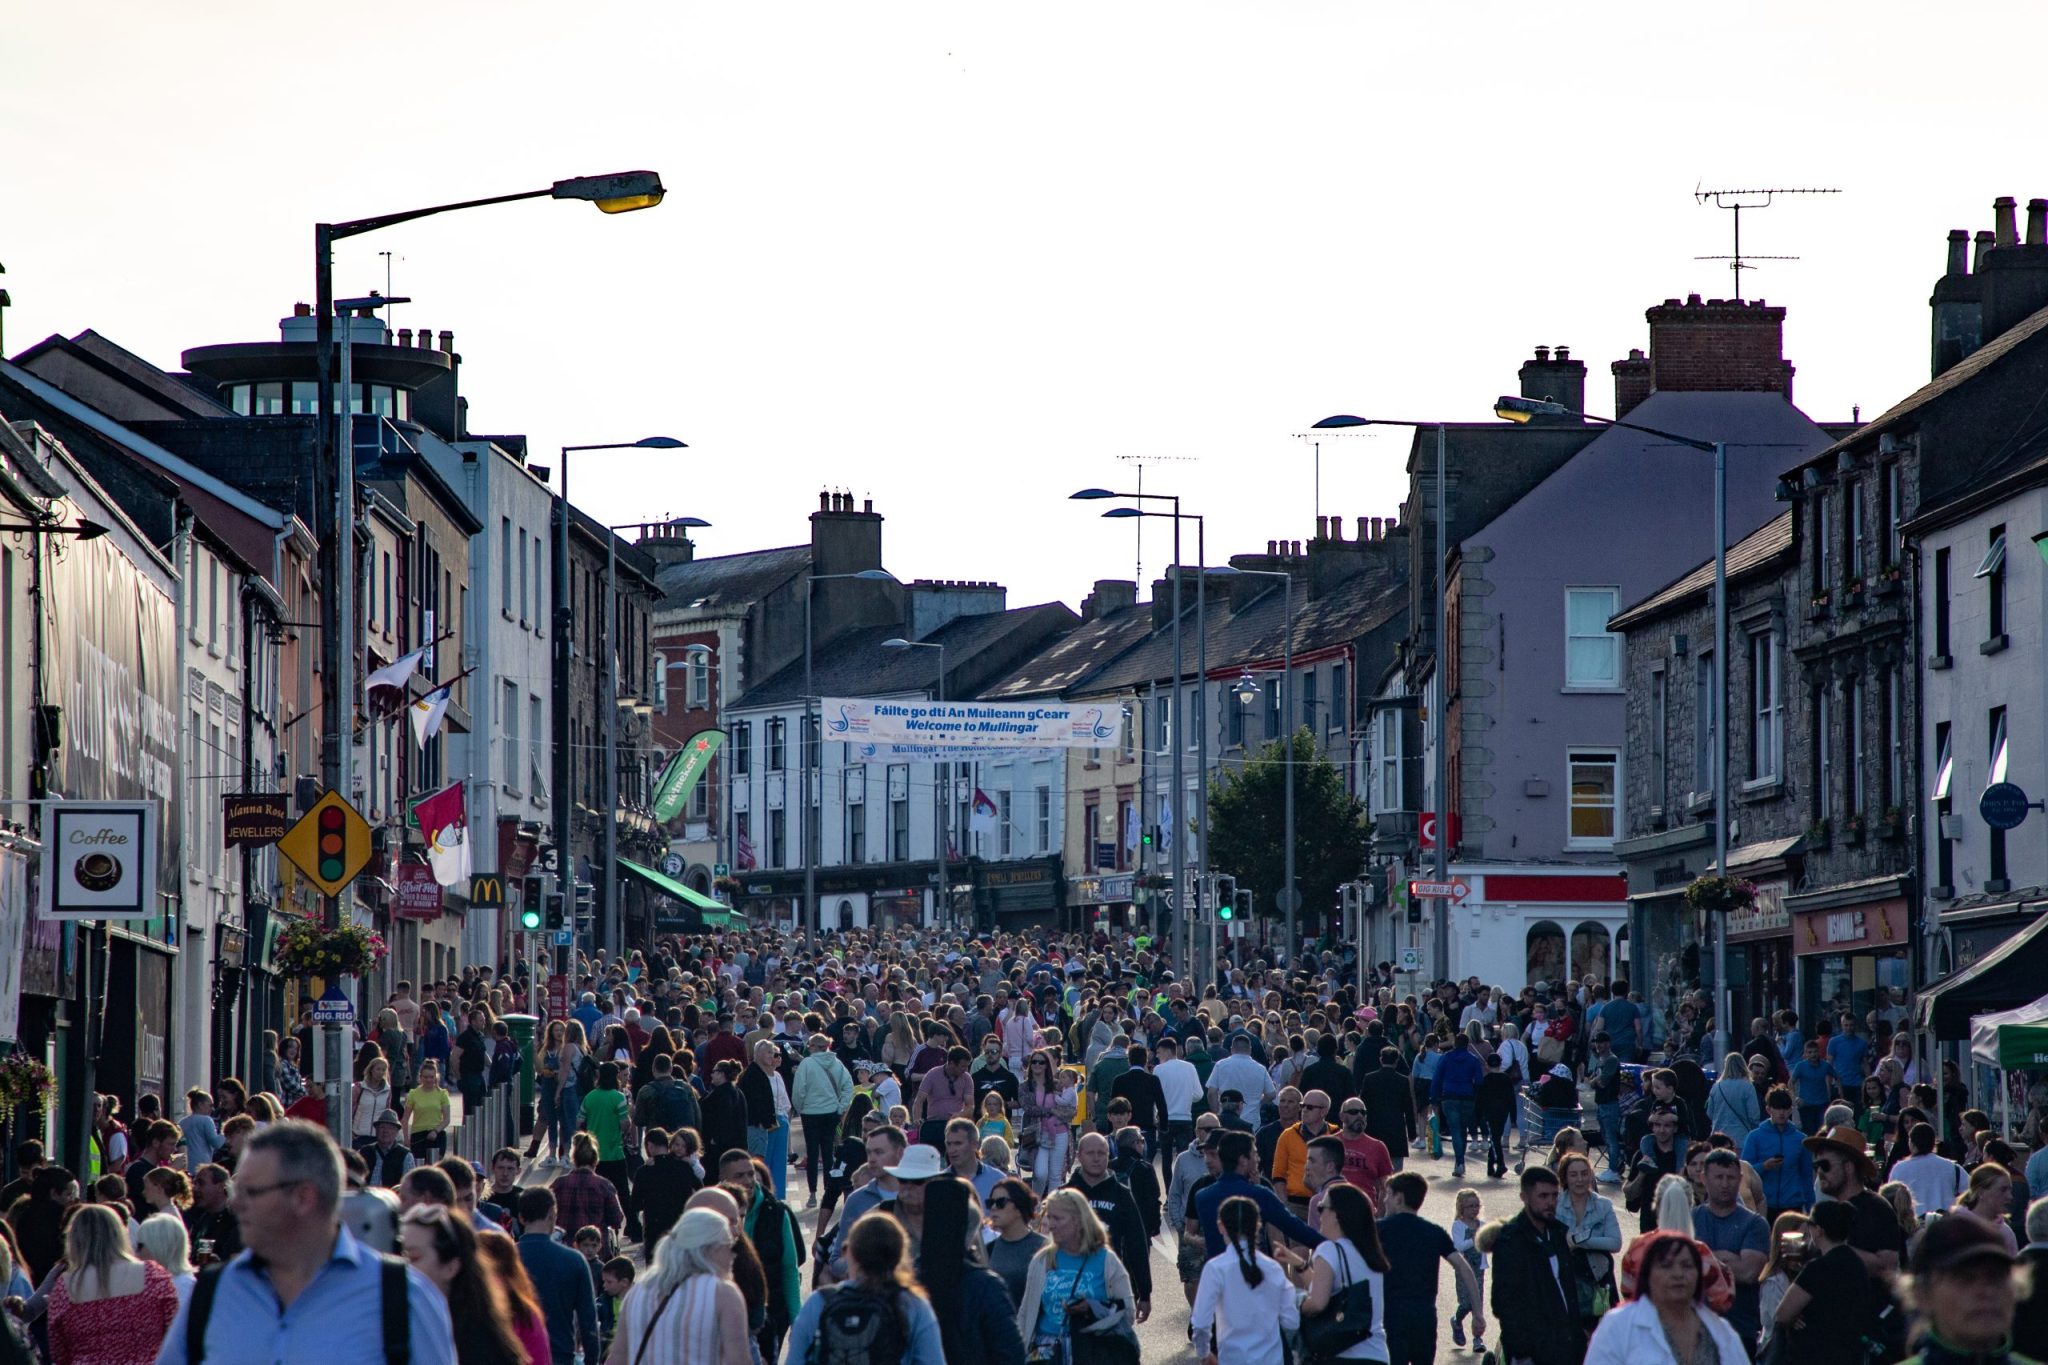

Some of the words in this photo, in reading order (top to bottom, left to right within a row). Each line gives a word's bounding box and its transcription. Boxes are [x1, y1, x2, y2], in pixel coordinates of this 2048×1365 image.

[874, 705, 909, 716] Fáilte
[911, 708, 926, 719] go
[929, 707, 946, 718] dtí
[948, 708, 965, 718] An
[967, 708, 1026, 719] Muileann
[1027, 708, 1070, 720] gCearr
[906, 720, 960, 731] Welcome
[963, 721, 977, 731] to
[978, 722, 1039, 734] Mullingar
[665, 753, 698, 807] Heineken
[228, 803, 263, 820] Alanna
[265, 804, 285, 819] Rose
[69, 828, 129, 845] Coffee
[228, 826, 285, 838] JEWELLERS
[1106, 881, 1126, 897] KING
[559, 932, 567, 943] P
[314, 1012, 332, 1020] GIG
[335, 1012, 353, 1020] RIG
